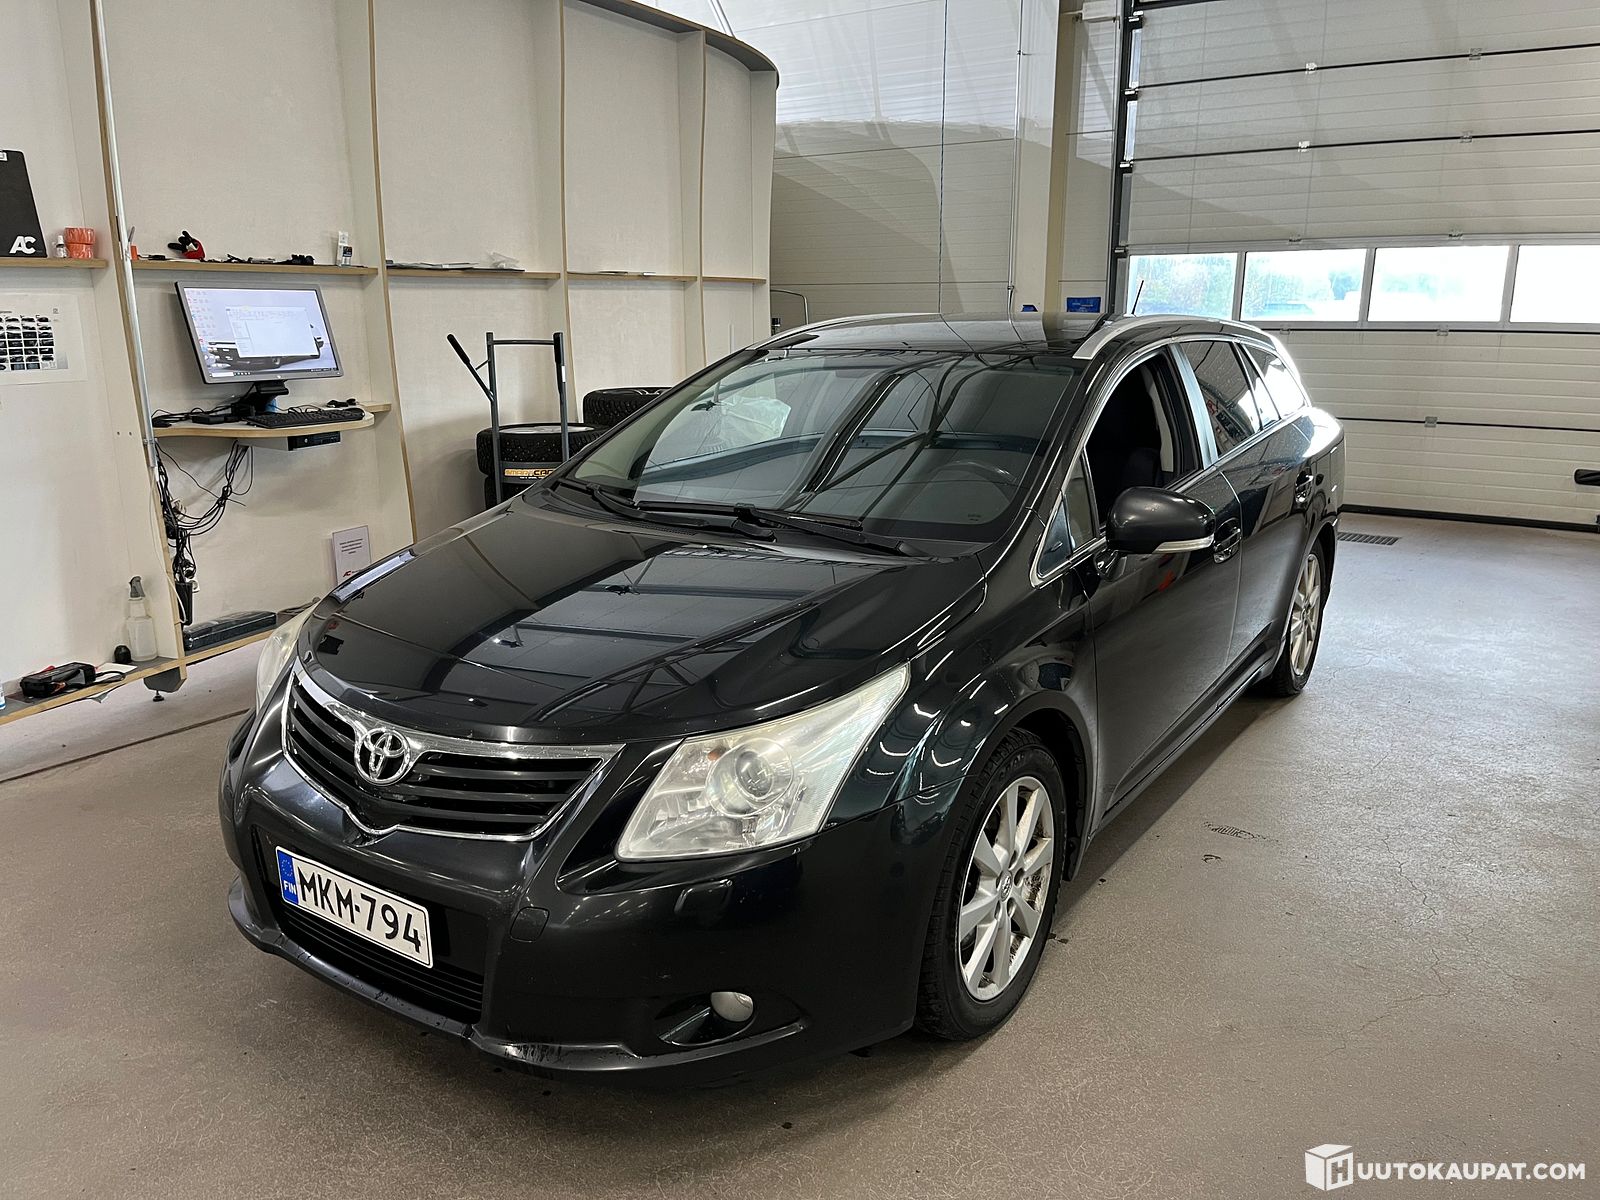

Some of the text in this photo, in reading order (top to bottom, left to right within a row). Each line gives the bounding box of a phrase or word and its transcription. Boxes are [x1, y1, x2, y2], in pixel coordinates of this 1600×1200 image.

[9, 236, 36, 255] AC
[283, 880, 297, 895] FIN
[297, 866, 422, 954] MKM-794
